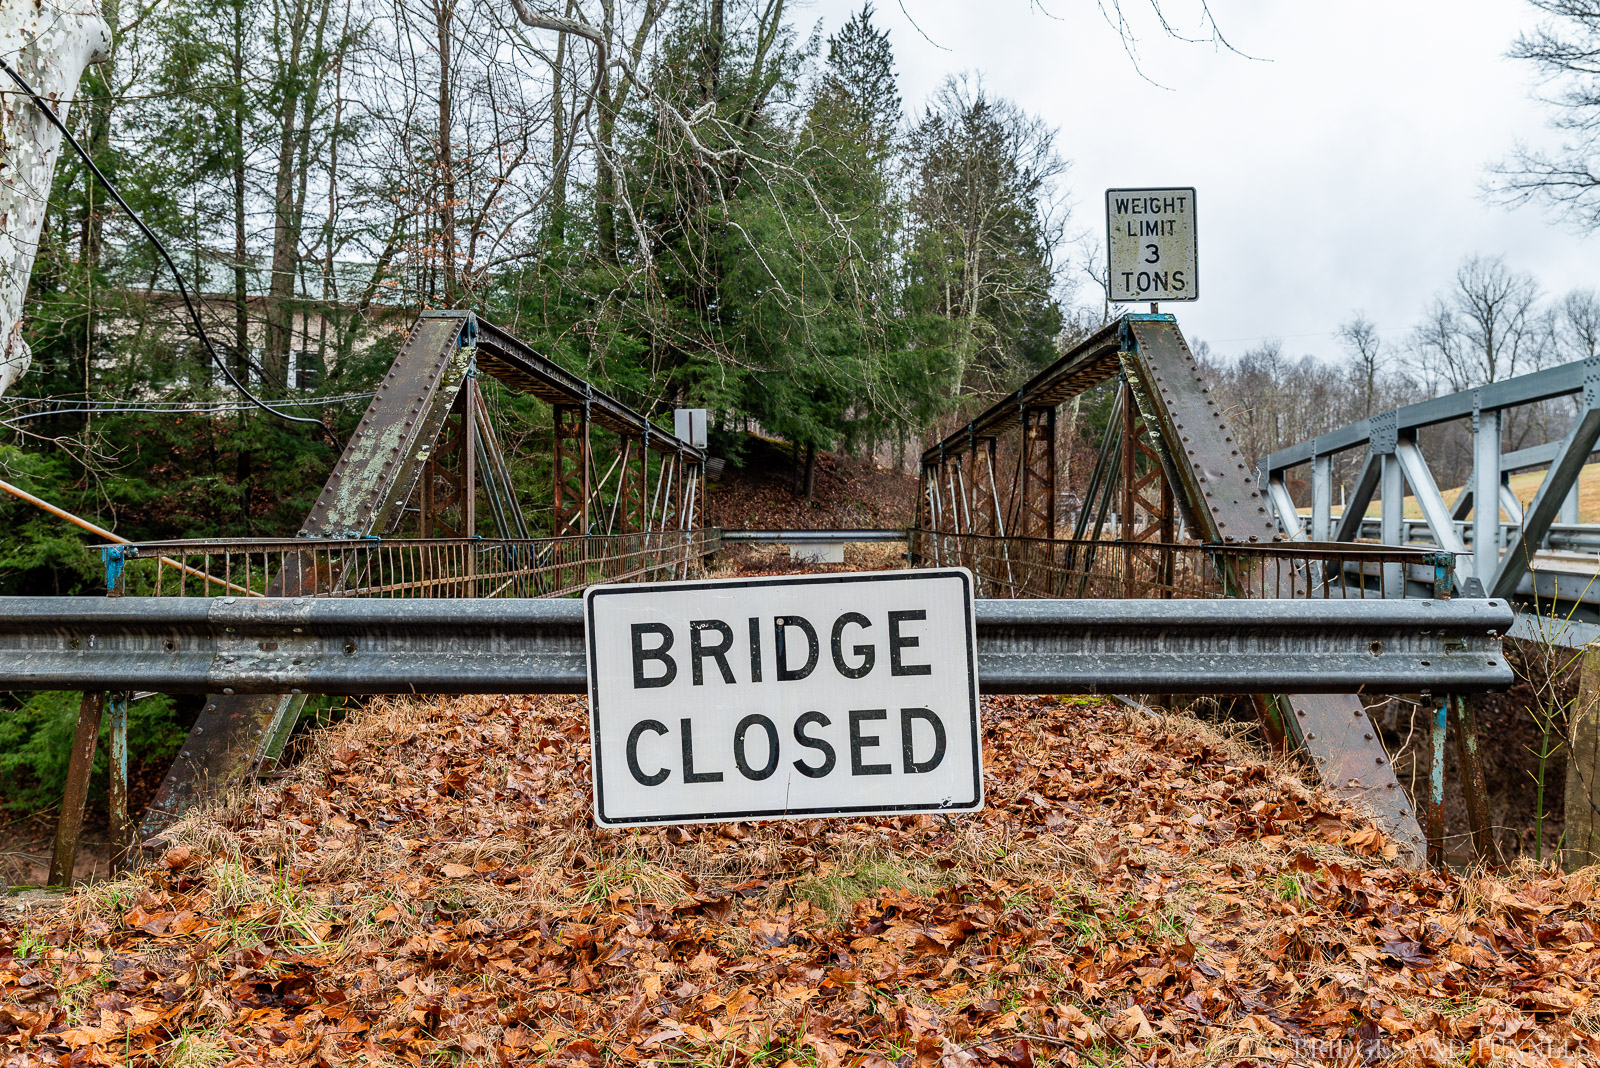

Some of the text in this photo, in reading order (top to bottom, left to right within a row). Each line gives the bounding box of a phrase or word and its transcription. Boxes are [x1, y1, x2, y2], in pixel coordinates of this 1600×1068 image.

[1115, 197, 1186, 214] WEIGHT
[1127, 220, 1176, 236] LIMIT
[1144, 243, 1160, 264] 3
[1121, 270, 1186, 292] TONS
[630, 609, 932, 689] BRIDGE
[626, 707, 947, 787] CLOSED
